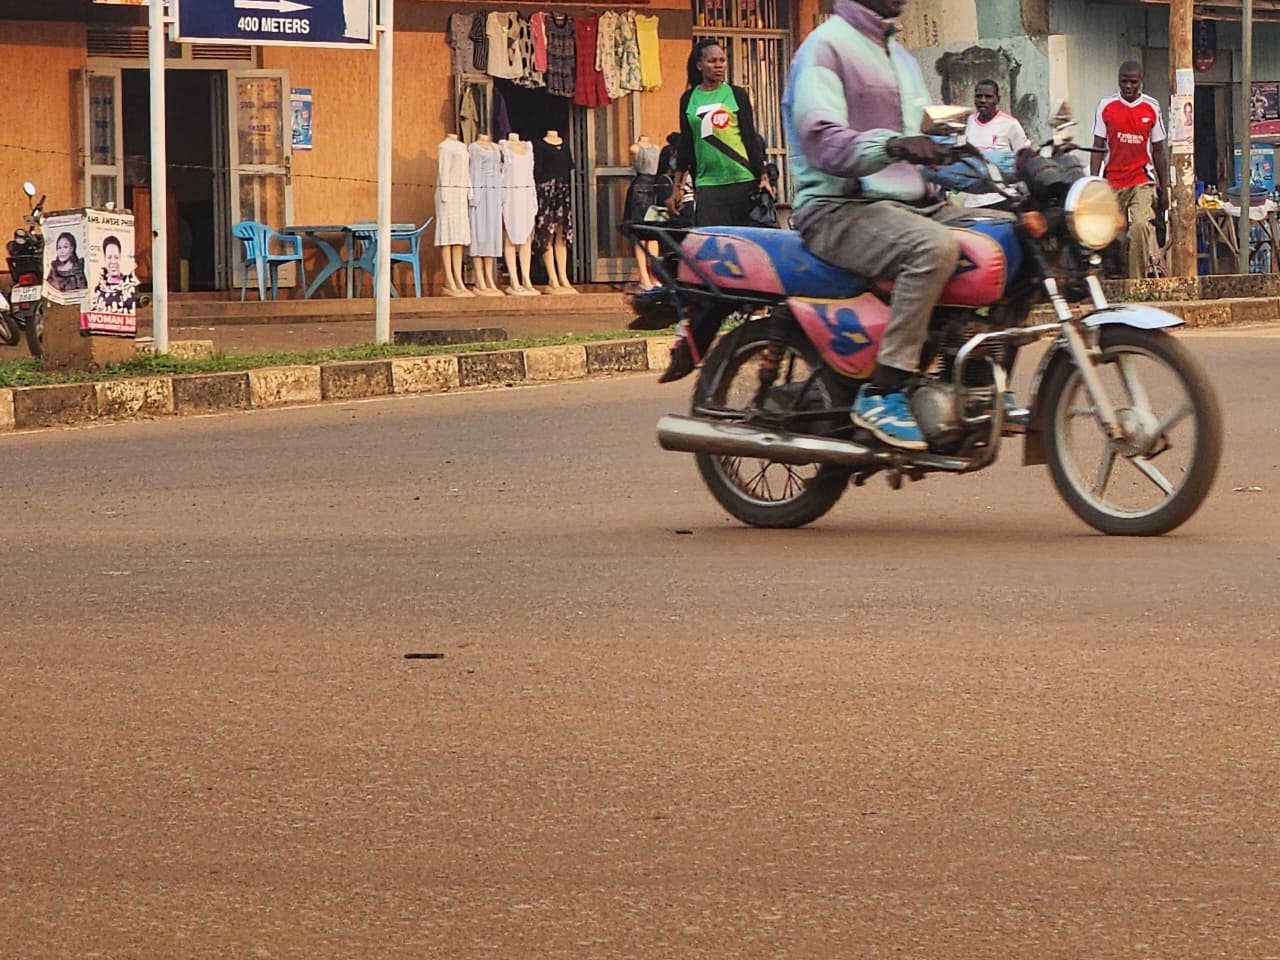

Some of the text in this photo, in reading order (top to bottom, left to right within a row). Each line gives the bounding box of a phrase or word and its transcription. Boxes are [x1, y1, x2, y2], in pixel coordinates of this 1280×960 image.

[237, 16, 310, 34] 400 METERS
[88, 313, 124, 325] WOMAN
